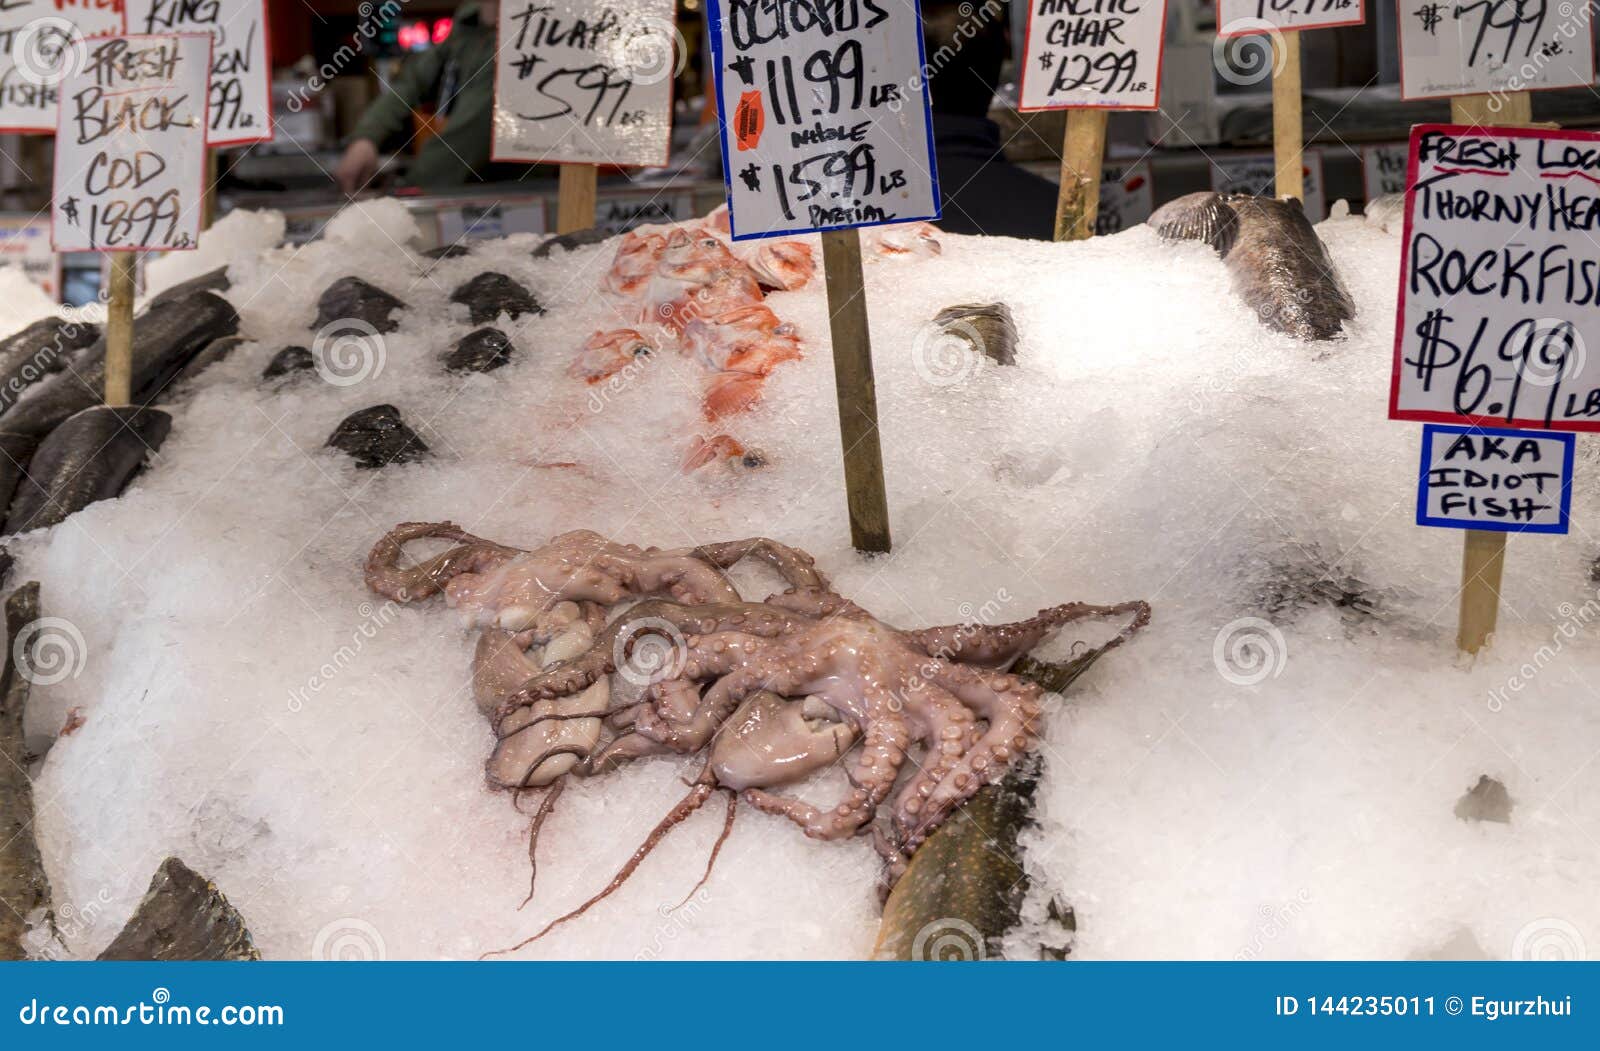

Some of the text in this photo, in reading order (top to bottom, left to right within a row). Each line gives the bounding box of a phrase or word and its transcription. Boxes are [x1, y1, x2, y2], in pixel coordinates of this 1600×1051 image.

[145, 0, 219, 34] KING
[511, 3, 648, 50] TILAP
[729, 0, 889, 50] OCTOPUS
[1046, 18, 1125, 47] CHAR
[82, 37, 183, 86] FRESH
[870, 83, 902, 107] LB
[72, 86, 193, 144] BLACK
[1419, 131, 1521, 171] FRESH
[1537, 139, 1600, 170] LOC
[85, 151, 165, 195] COD
[880, 170, 907, 194] LB
[808, 199, 896, 228] PARTIAL
[1404, 308, 1575, 429] $6.99
[1444, 434, 1542, 464] AKA
[1428, 468, 1560, 494] IDIOT
[1440, 492, 1553, 521] FISH
